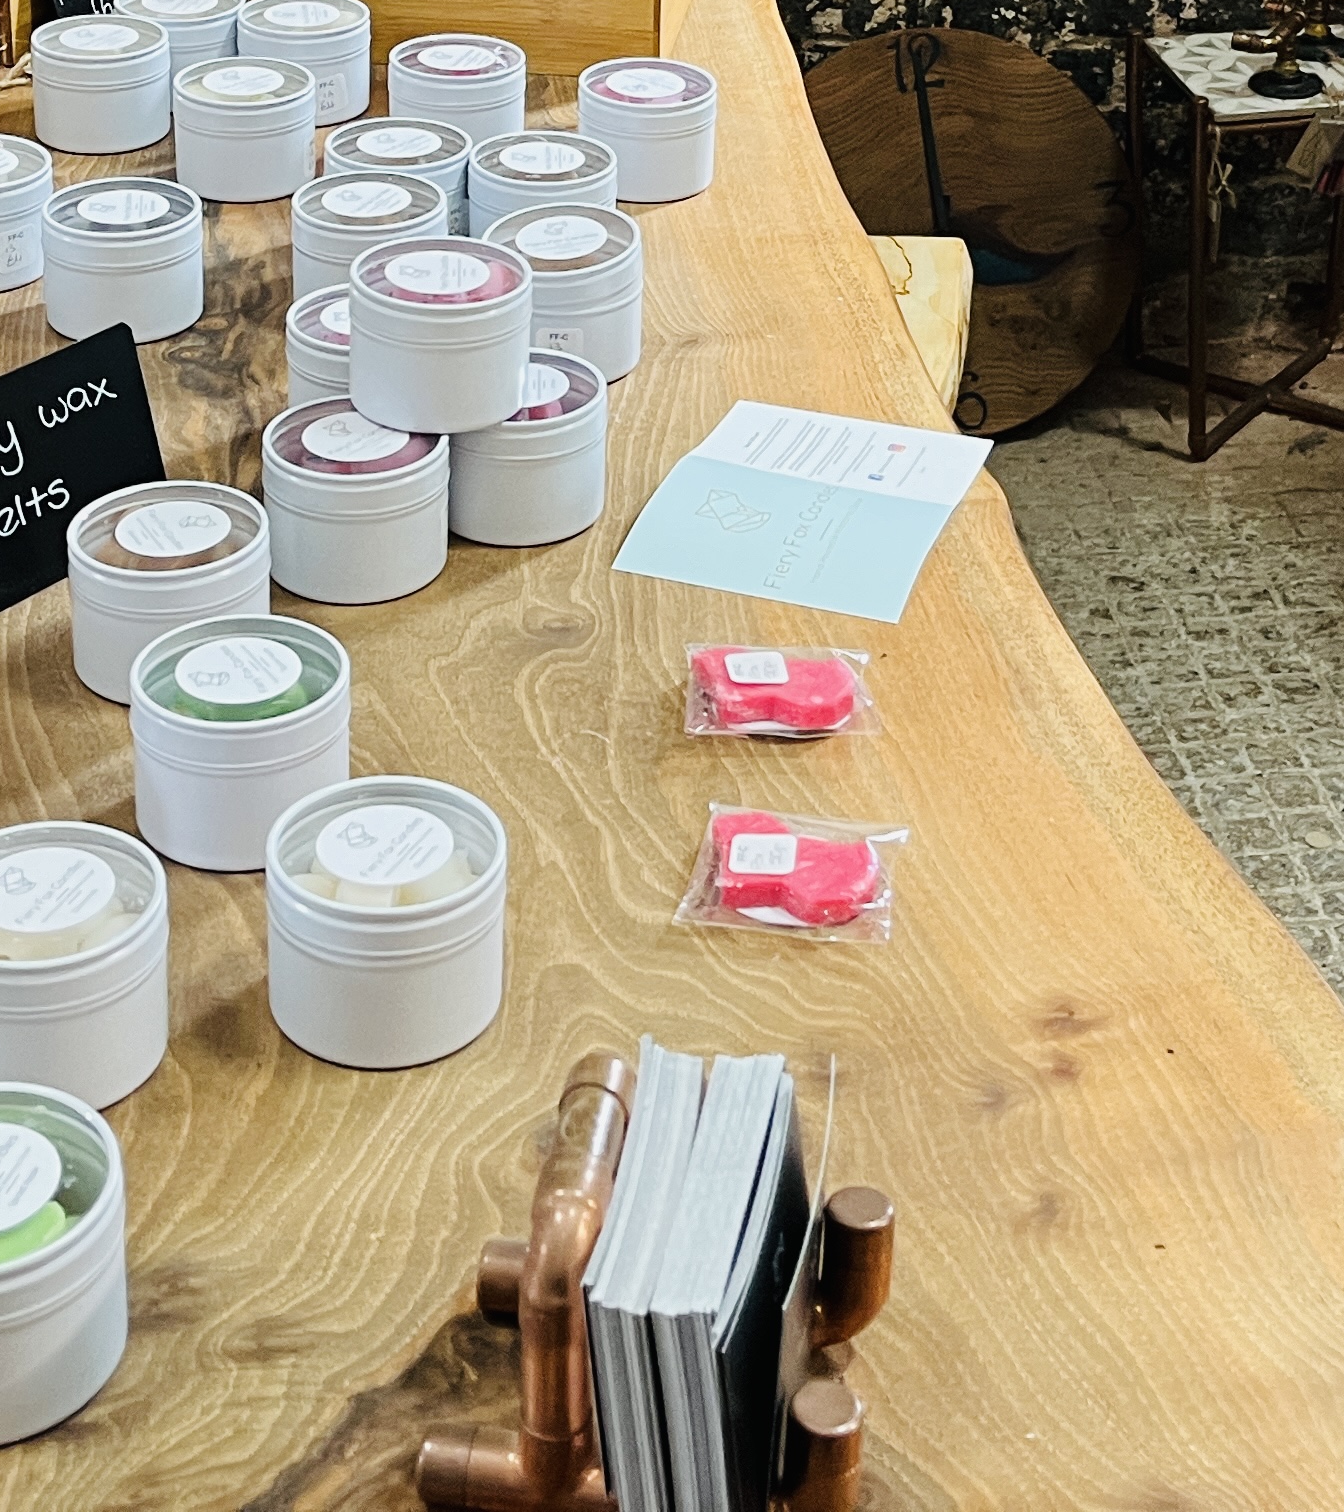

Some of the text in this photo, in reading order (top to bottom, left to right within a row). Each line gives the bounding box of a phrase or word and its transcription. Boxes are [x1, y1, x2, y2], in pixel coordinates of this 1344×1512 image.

[37, 377, 118, 428] wax
[782, 521, 812, 550] Fox
[763, 548, 802, 590] Fiery
